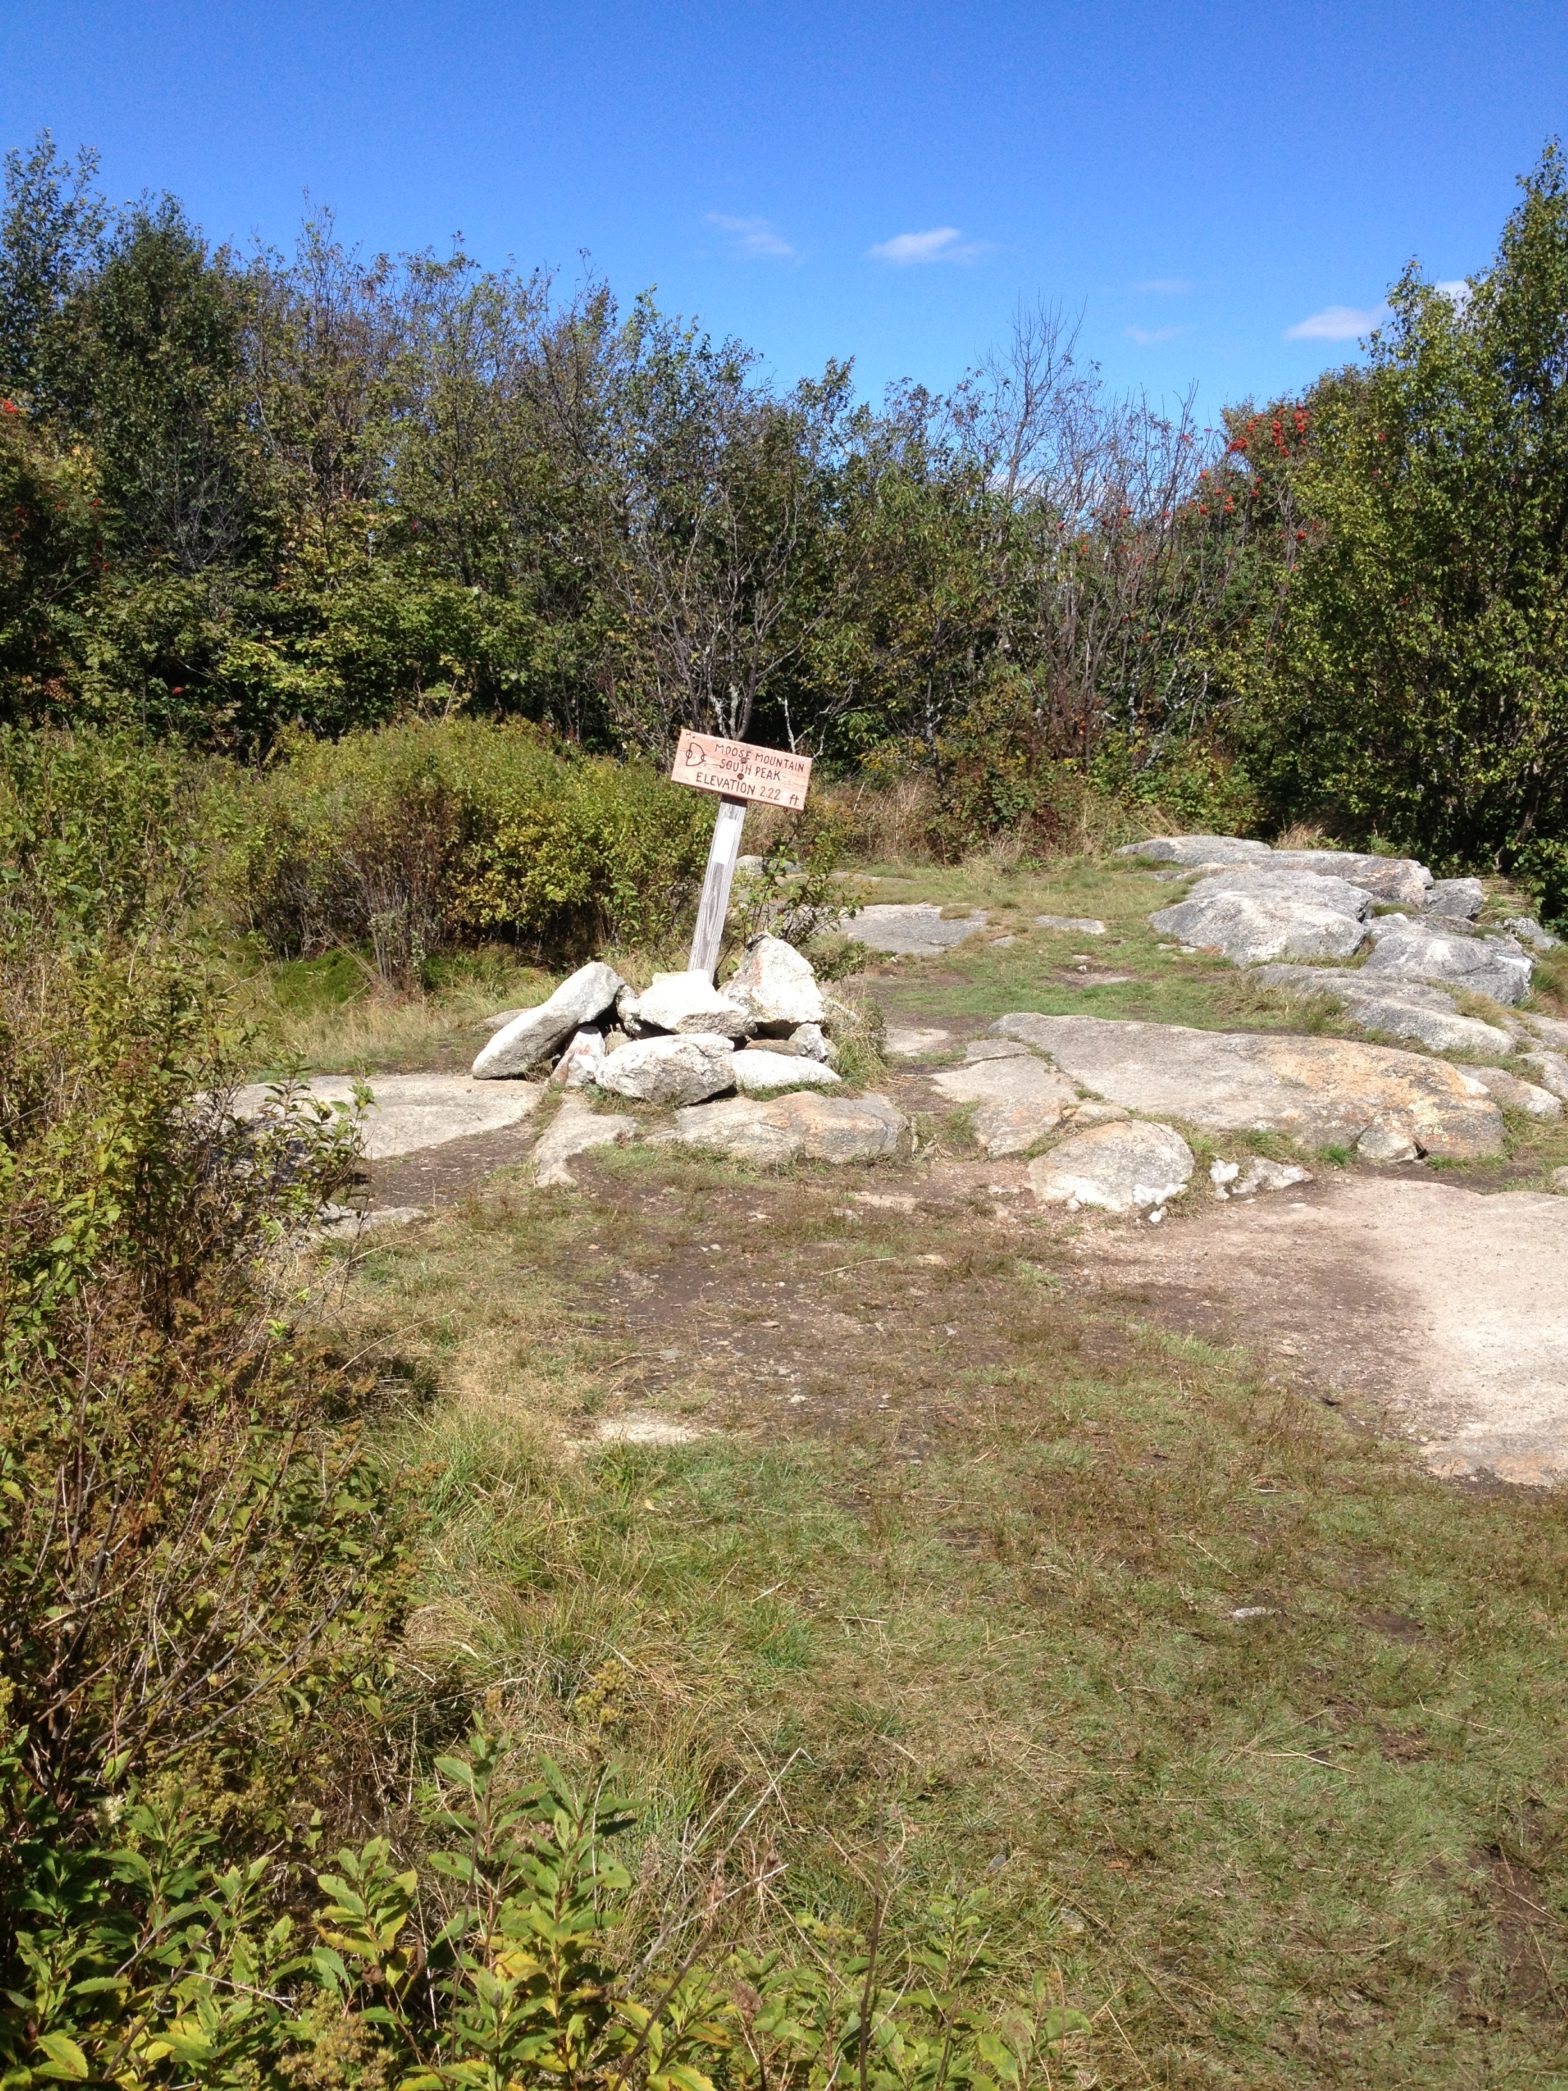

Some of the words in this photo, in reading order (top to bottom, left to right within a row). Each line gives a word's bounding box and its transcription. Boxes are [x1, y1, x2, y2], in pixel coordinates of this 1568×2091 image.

[714, 743, 751, 760] MOOSE
[755, 752, 805, 773] MOUNTAIN
[719, 758, 751, 775] SOUTH
[755, 766, 781, 782] PEAK
[696, 771, 756, 796] ELEVATION
